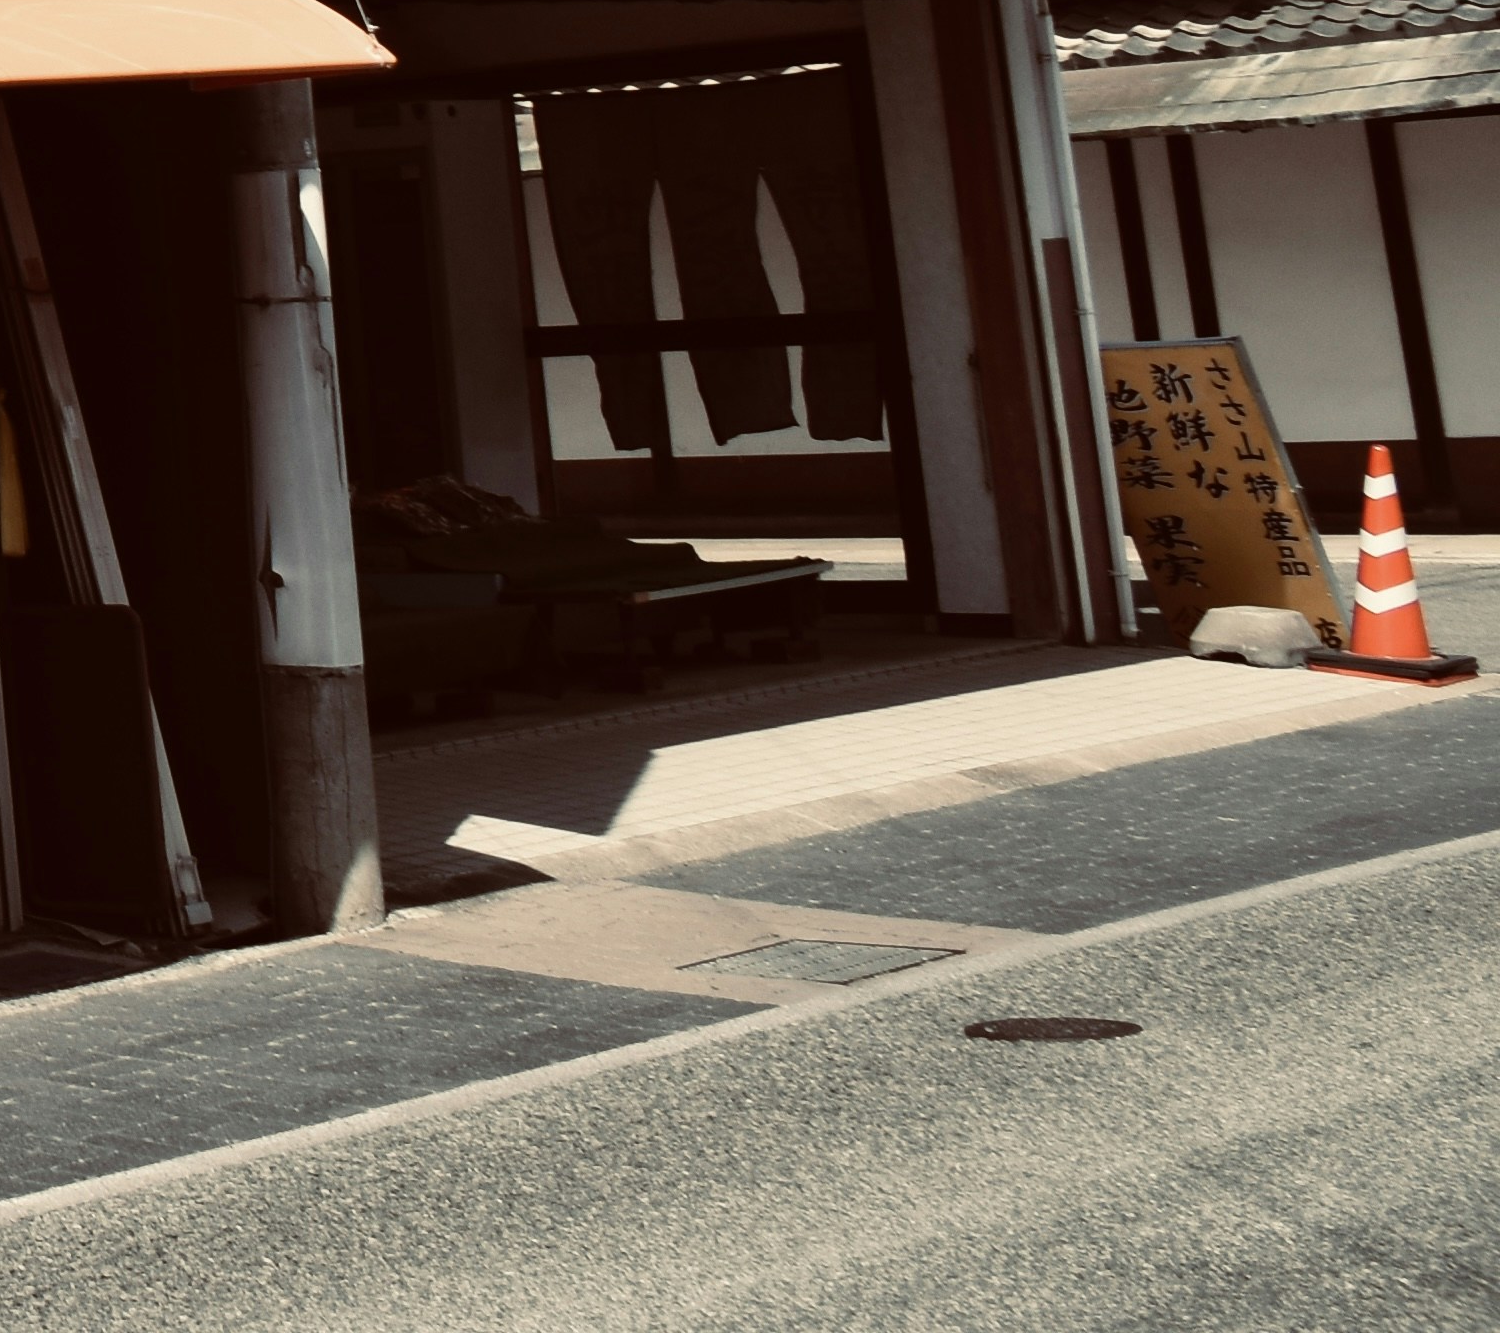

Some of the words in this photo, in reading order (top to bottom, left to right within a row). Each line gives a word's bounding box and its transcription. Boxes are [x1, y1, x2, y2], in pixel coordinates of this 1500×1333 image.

[1150, 363, 1229, 498] 新鮮な
[1205, 358, 1310, 576] ささ山特産品
